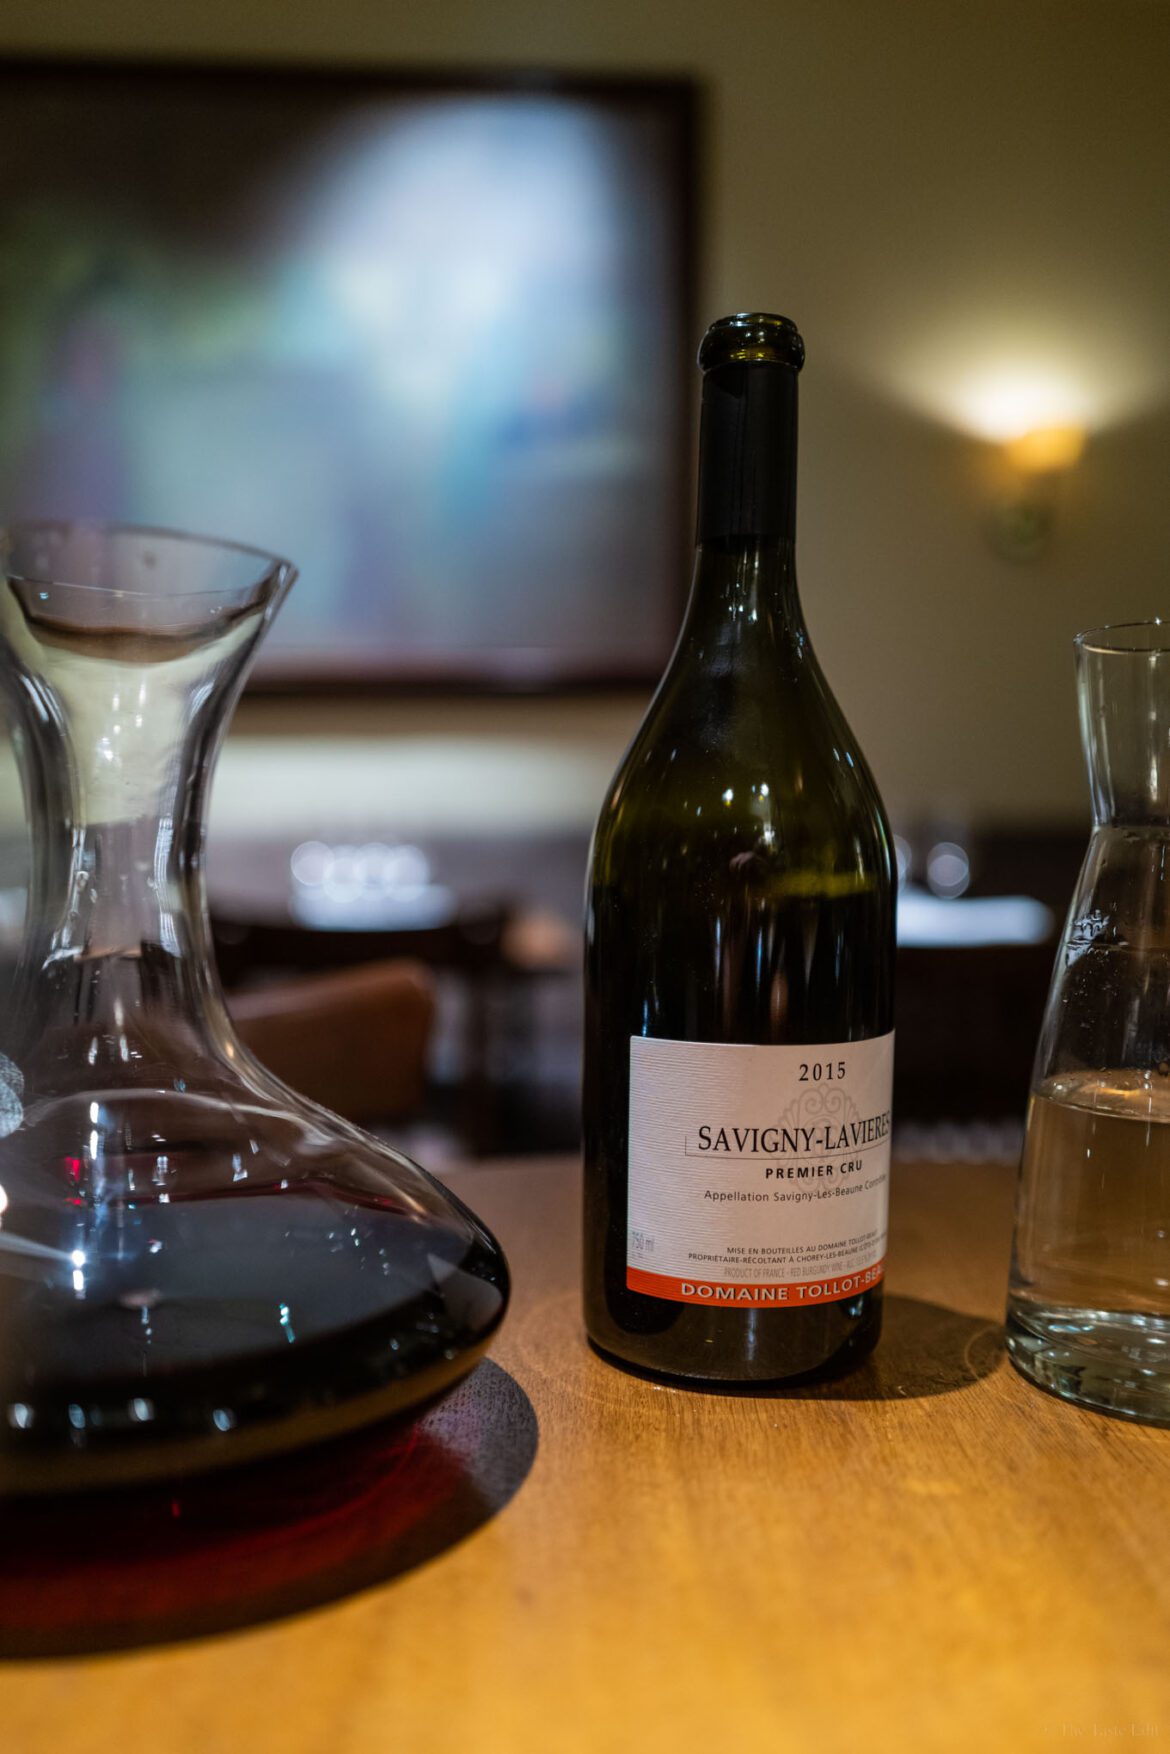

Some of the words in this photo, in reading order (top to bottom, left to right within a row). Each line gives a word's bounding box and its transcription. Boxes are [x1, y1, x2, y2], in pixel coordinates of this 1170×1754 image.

[798, 1061, 847, 1081] 2015
[697, 1110, 891, 1153] SAVIGNY-LAVIERES
[765, 1165, 833, 1179] PREMIER
[840, 1160, 863, 1174] CRU
[704, 1190, 769, 1202] Appellation
[773, 1183, 863, 1203] Savigny-Les-Beaune
[726, 1246, 746, 1255] MISE
[748, 1247, 759, 1255] EN
[761, 1245, 804, 1255] BOUTEILLES
[818, 1241, 847, 1250] DOMAINE
[681, 1283, 789, 1301] DOMAINE
[796, 1264, 883, 1299] TOLLOT-BEA
